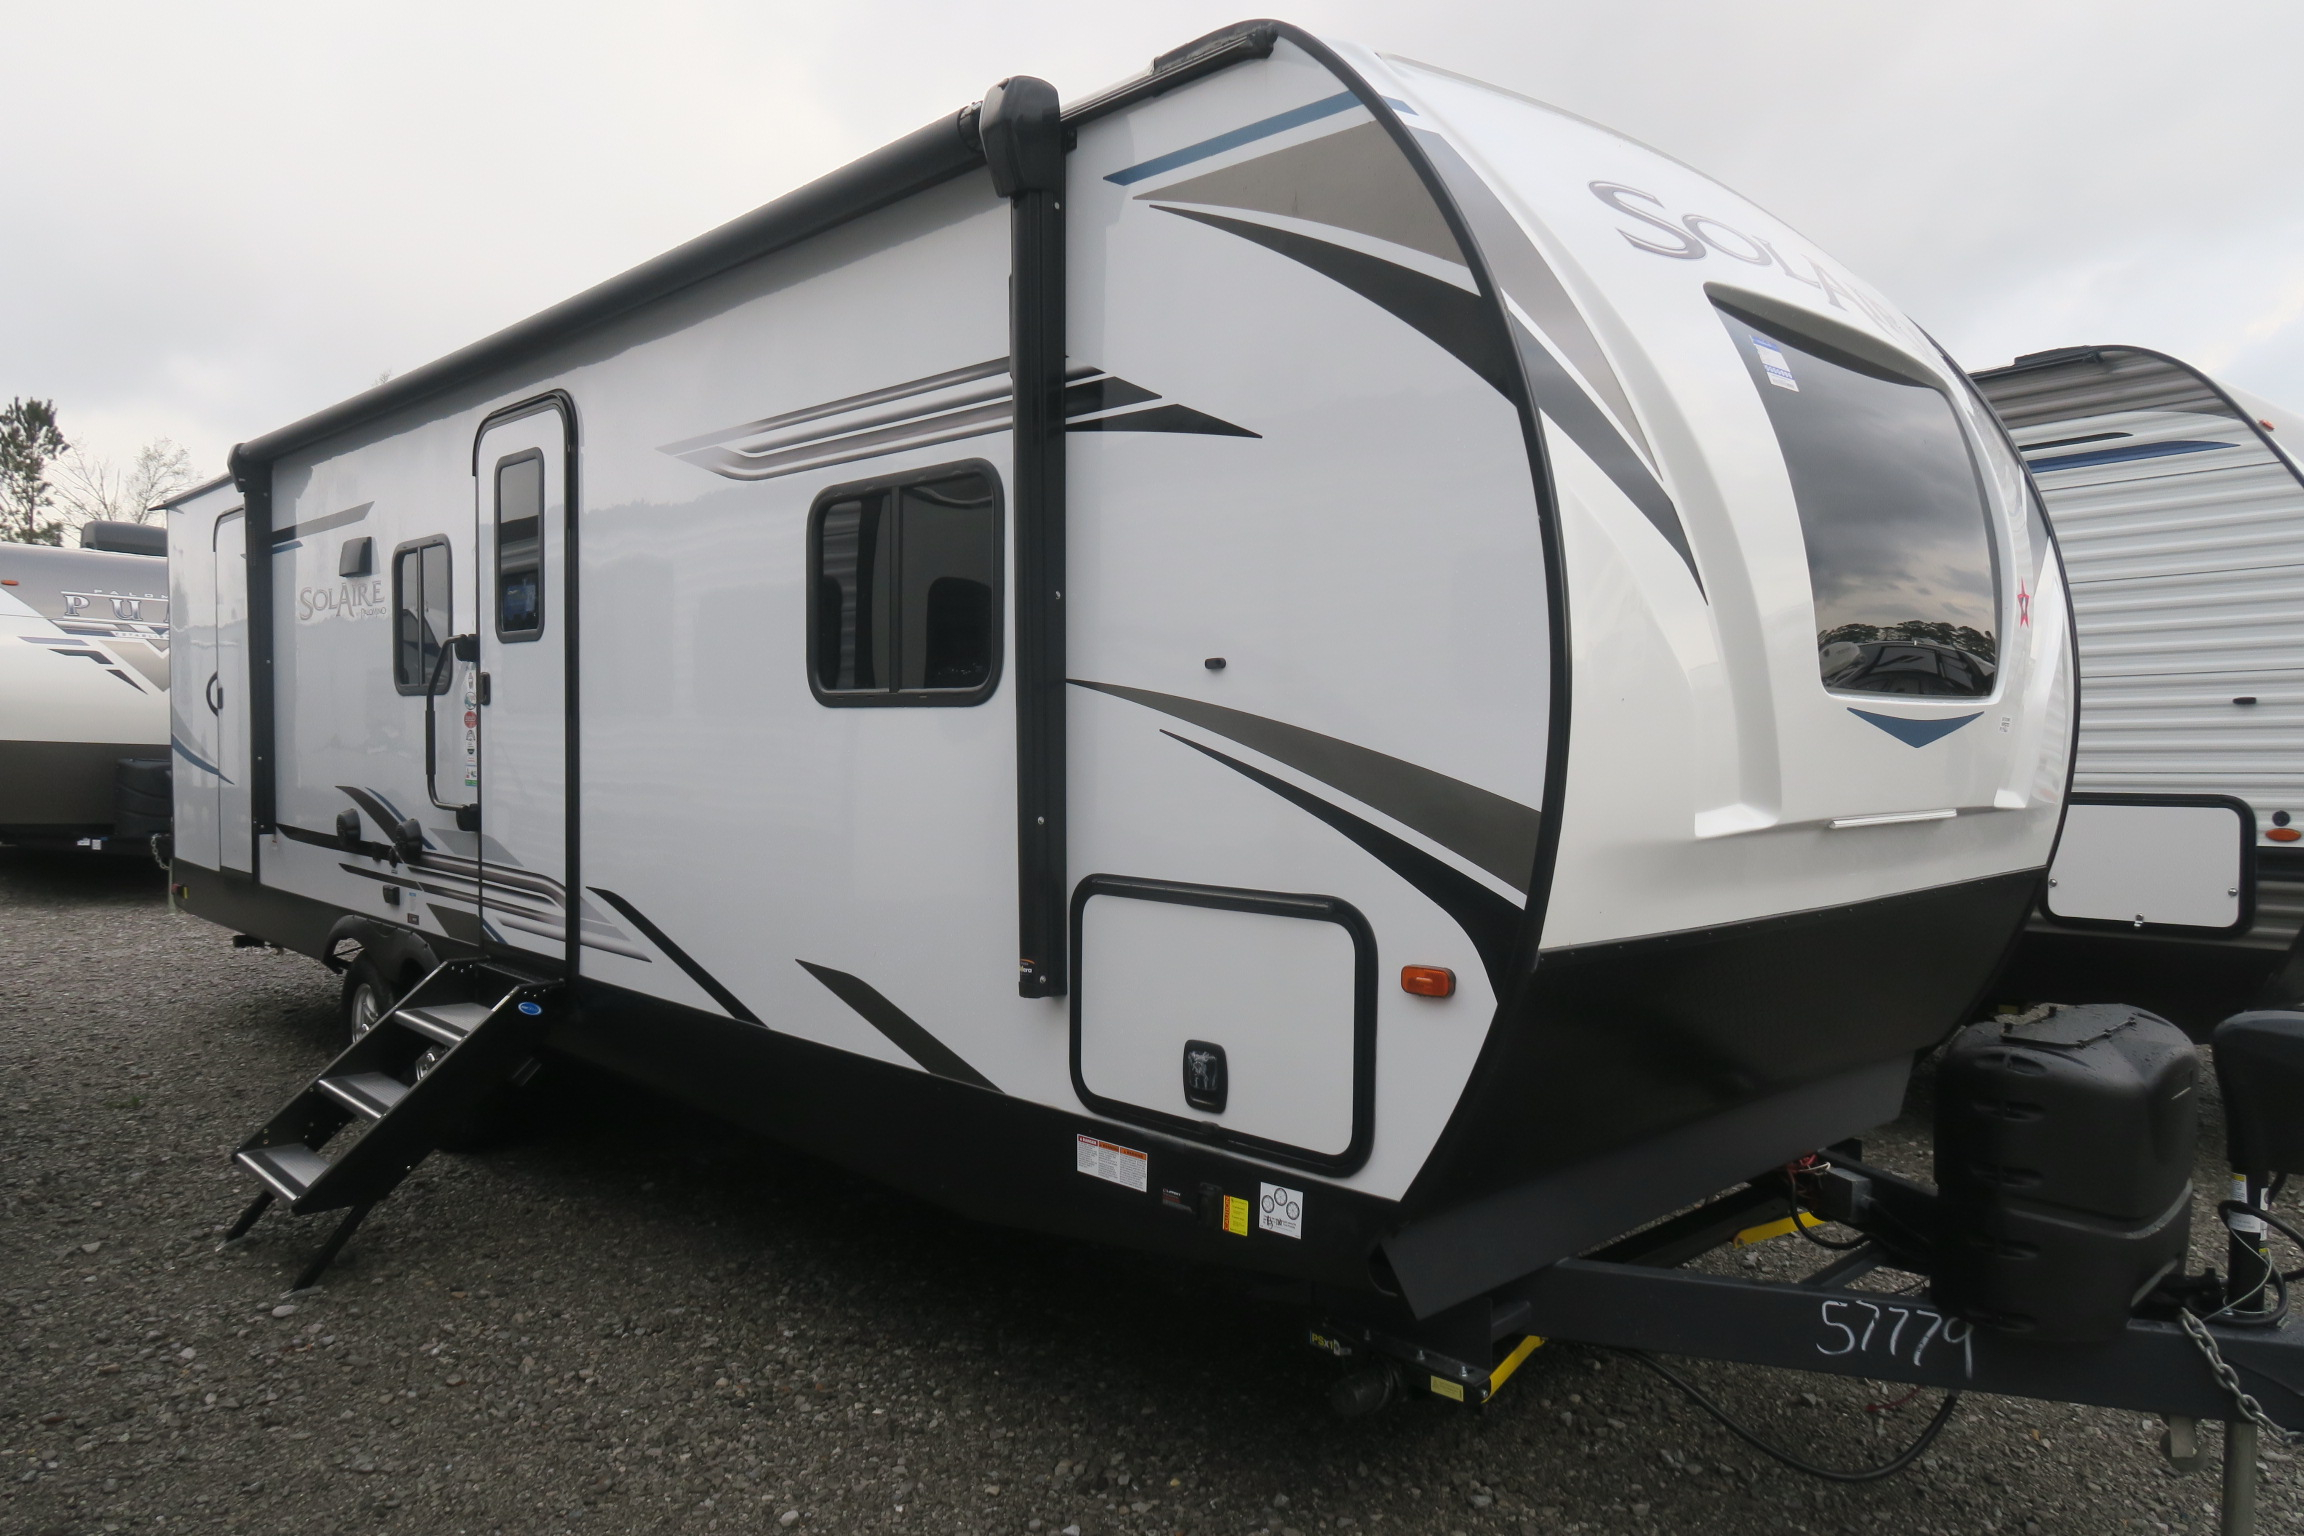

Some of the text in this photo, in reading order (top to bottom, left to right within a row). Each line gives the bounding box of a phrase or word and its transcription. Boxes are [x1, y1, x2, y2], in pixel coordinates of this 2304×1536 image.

[63, 594, 169, 623] PU
[299, 580, 386, 621] SOLAIRE
[1816, 1299, 1973, 1380] 57779
